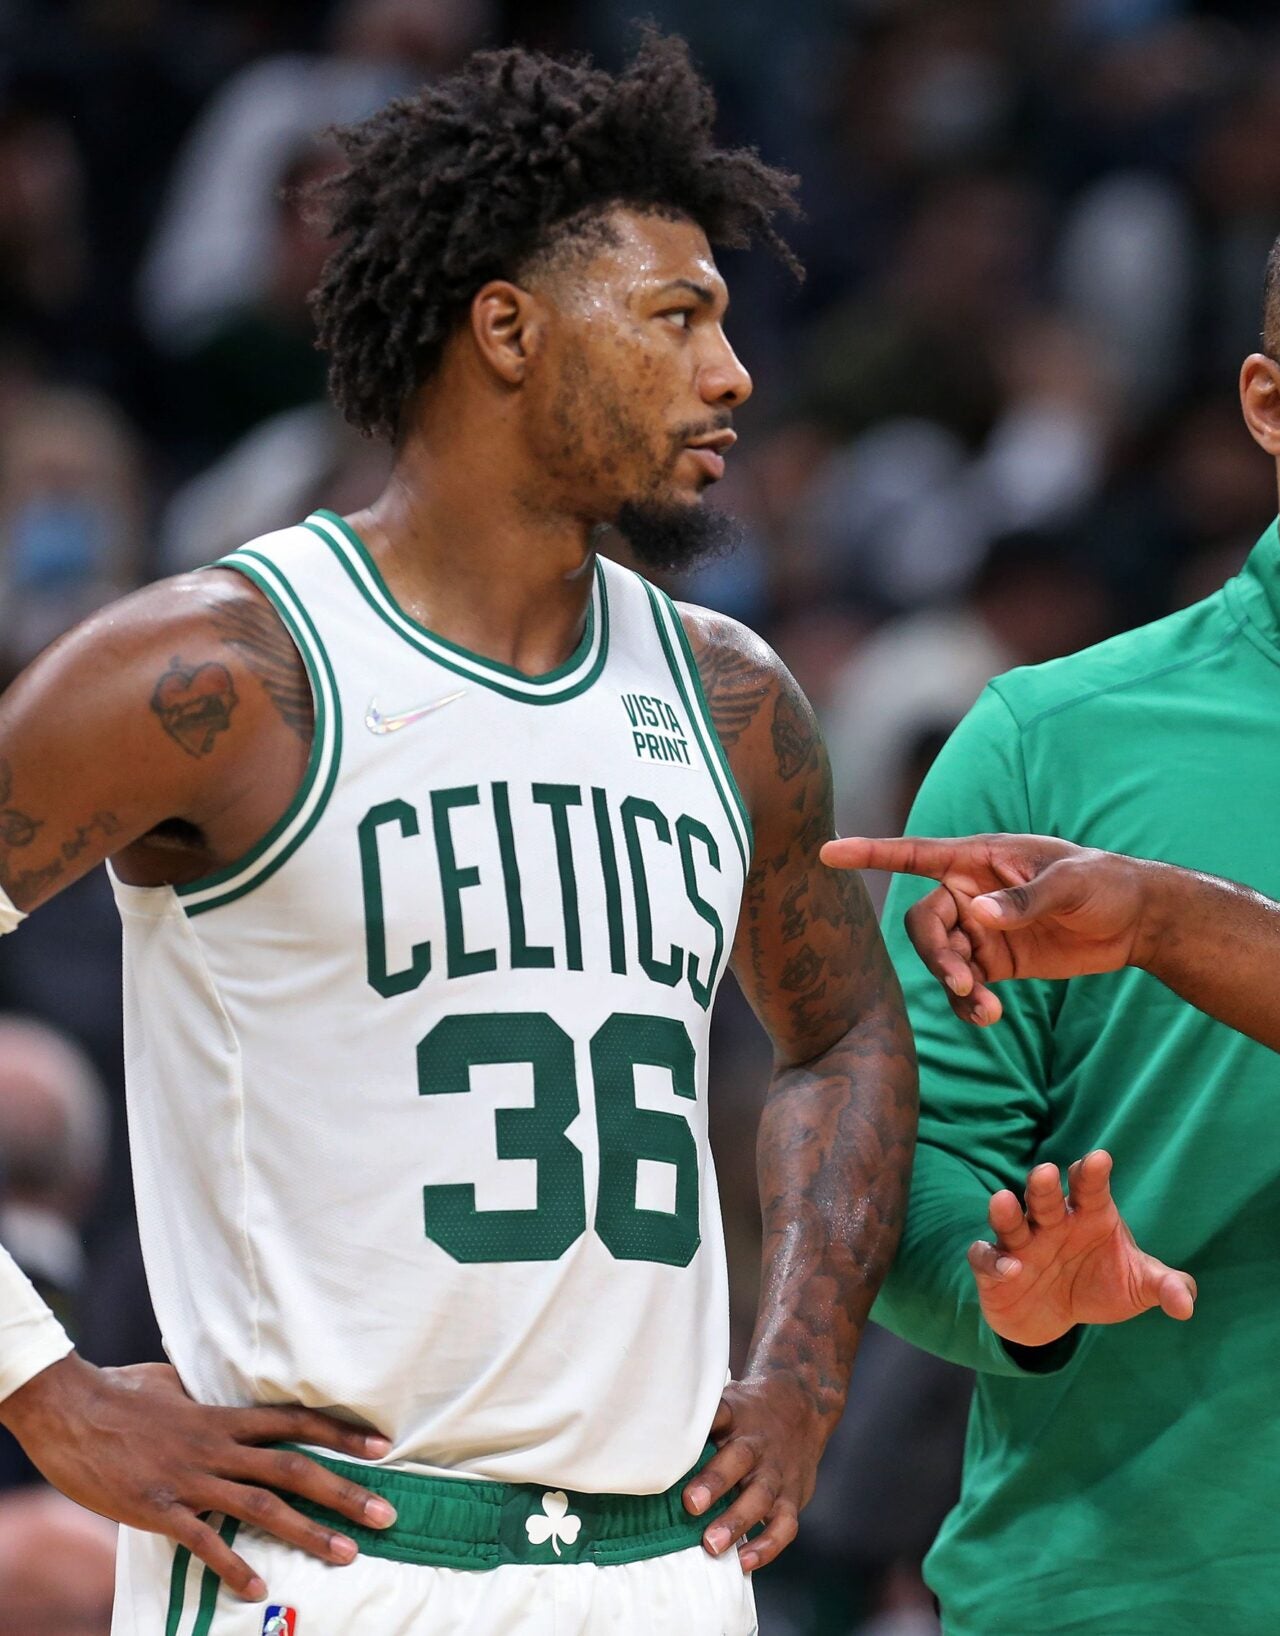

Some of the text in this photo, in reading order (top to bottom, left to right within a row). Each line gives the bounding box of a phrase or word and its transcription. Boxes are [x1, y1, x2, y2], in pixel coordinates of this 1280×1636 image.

[620, 693, 685, 738] VISTA
[632, 730, 691, 765] PRINT
[357, 781, 724, 1012] CELTICS
[416, 1011, 701, 1268] 36
